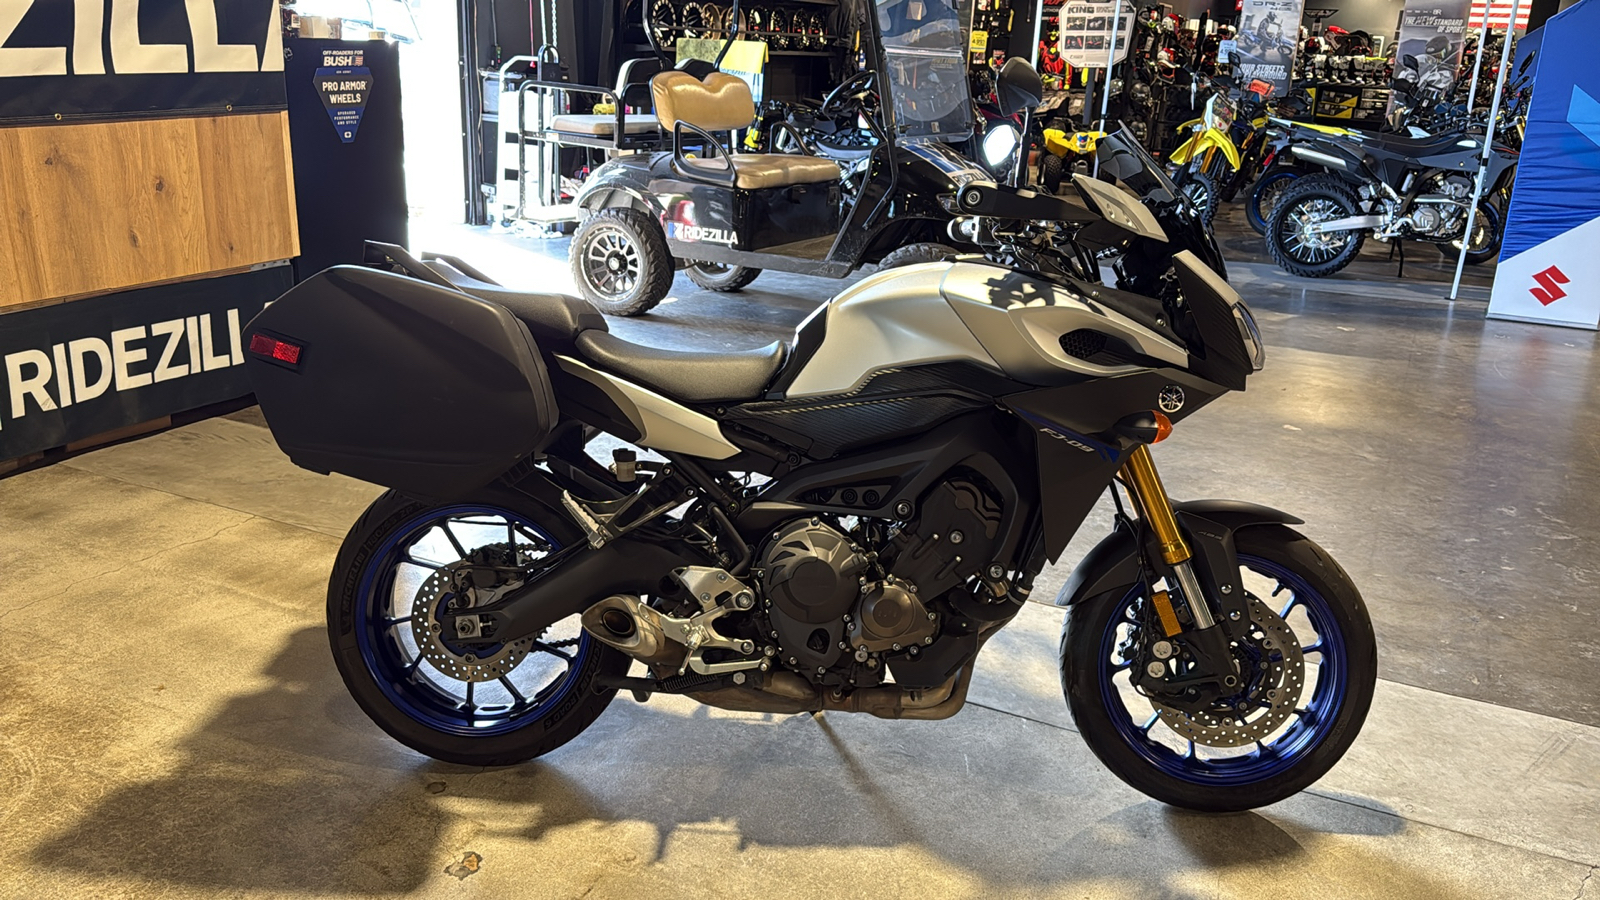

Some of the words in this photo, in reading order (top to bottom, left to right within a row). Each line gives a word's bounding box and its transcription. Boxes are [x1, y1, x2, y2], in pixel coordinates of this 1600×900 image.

[1405, 17, 1416, 25] THE
[1415, 15, 1436, 25] NEW
[323, 56, 352, 66] BUSH
[322, 82, 338, 91] PRO
[340, 81, 366, 90] ARMOR
[329, 93, 361, 104] WHEELS
[684, 225, 738, 245] RIDEZILLA
[1039, 427, 1096, 453] FJ-09
[342, 552, 366, 613] MICHELIN
